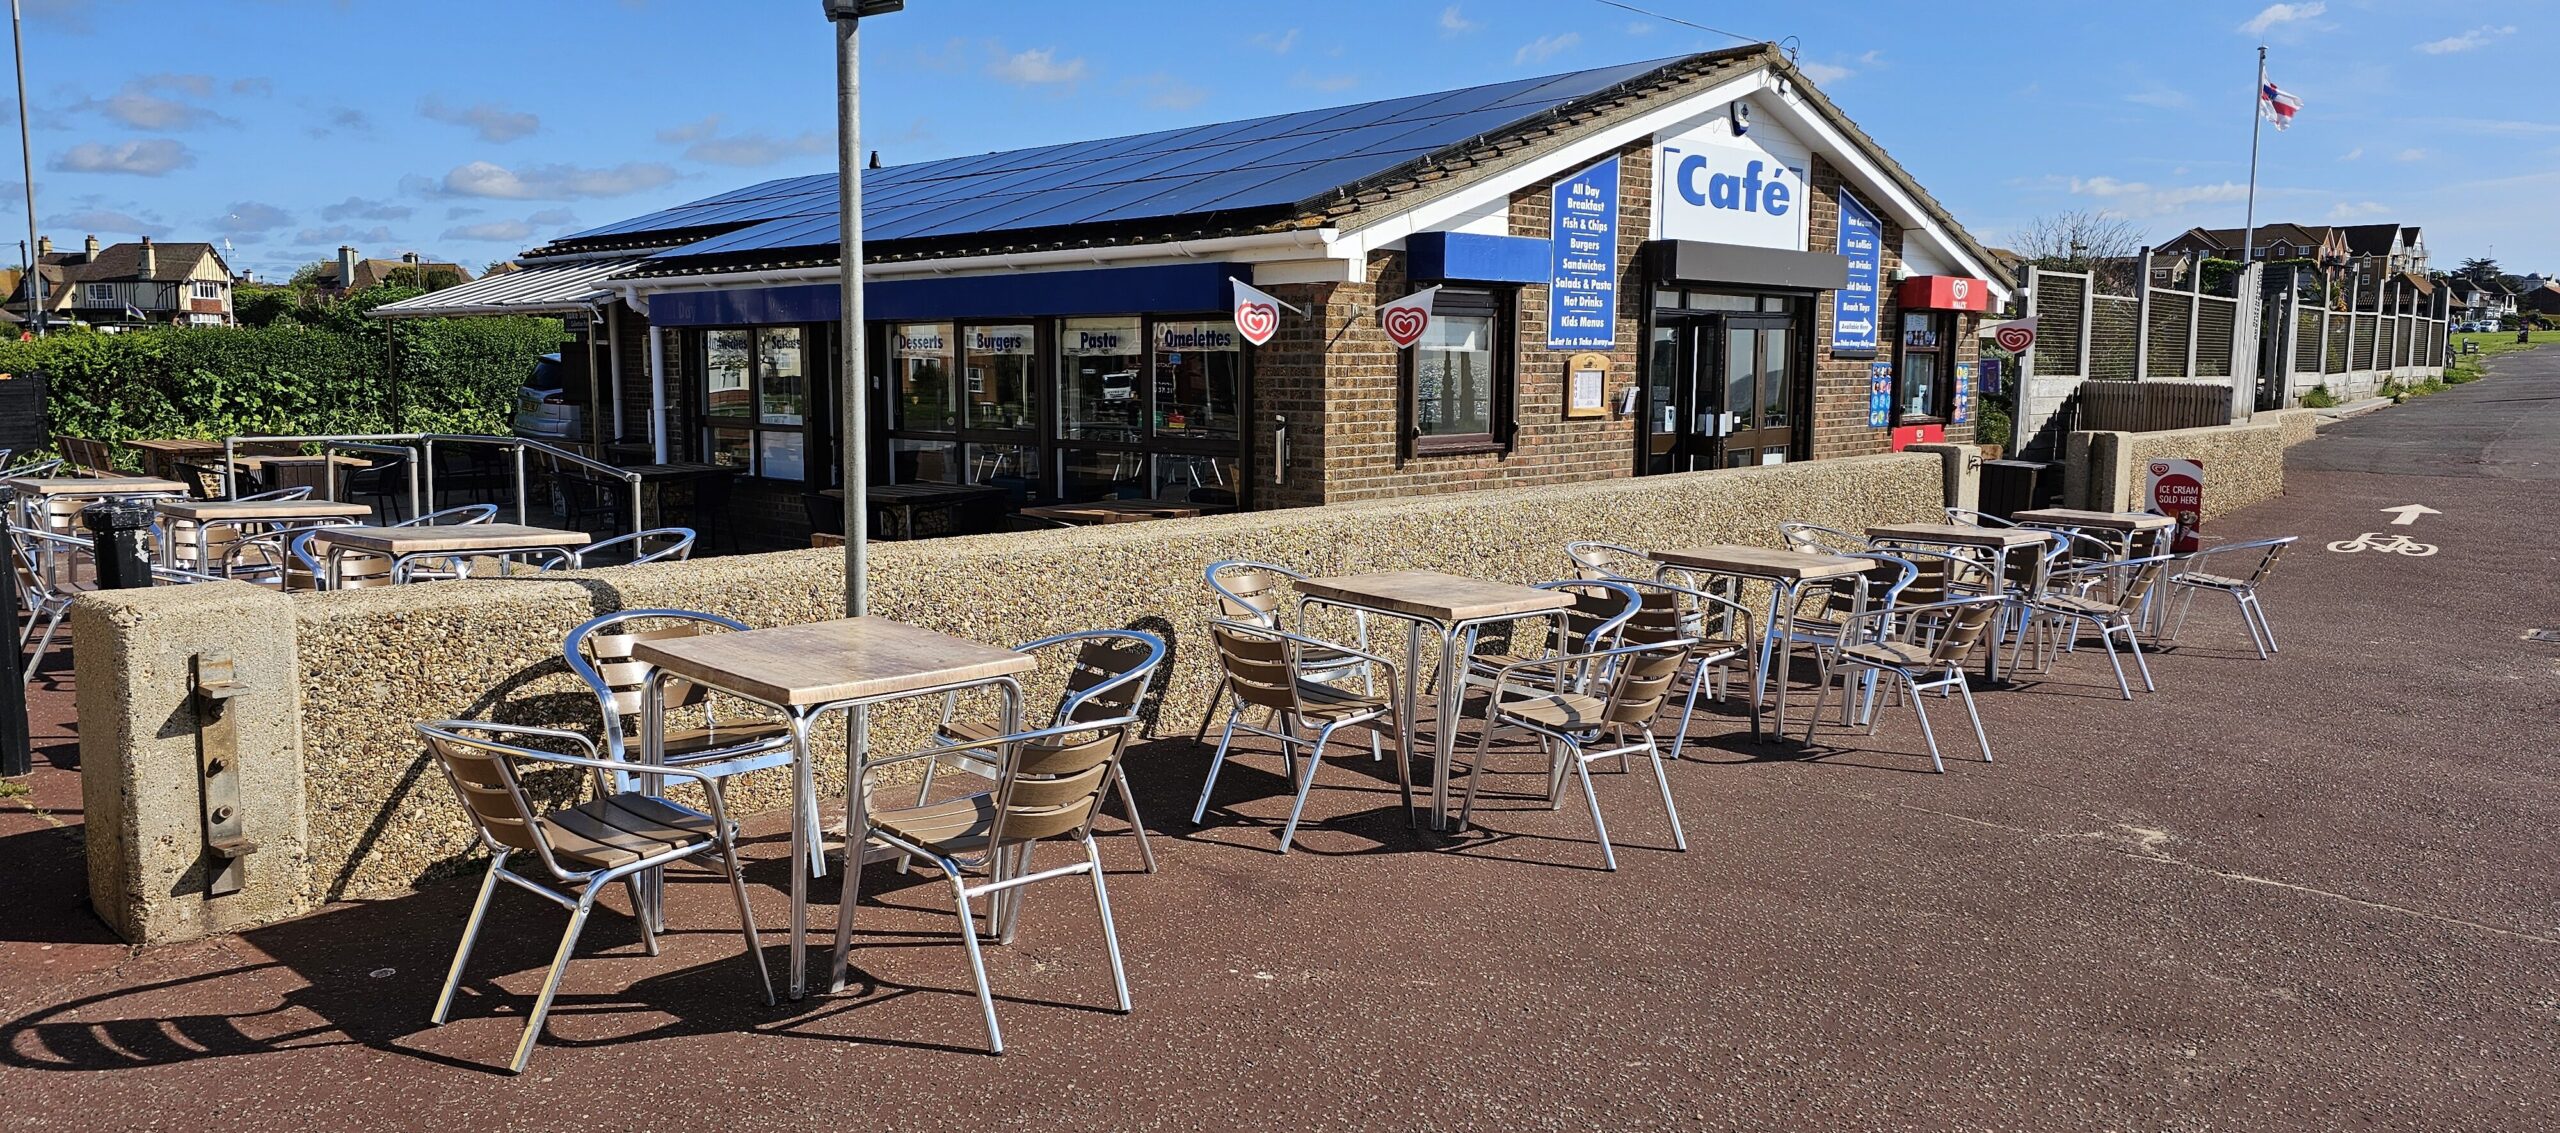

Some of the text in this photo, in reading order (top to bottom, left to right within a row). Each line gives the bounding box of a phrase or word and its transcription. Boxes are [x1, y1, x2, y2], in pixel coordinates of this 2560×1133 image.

[1572, 183, 1600, 198] All Day
[1677, 154, 1790, 216] Café
[1567, 197, 1605, 212] Breakfast
[1562, 217, 1608, 232] Fish & Chips
[1570, 238, 1600, 252] Burgers
[1562, 258, 1606, 271] Sandwiches
[1855, 260, 1872, 270] Drinks
[1555, 277, 1612, 291] Salads & Pasta
[1856, 282, 1872, 292] Drinks
[1563, 296, 1603, 308] Hot Drinks
[1561, 315, 1604, 328] Kids Menus
[900, 334, 944, 350] Desserts
[976, 332, 1022, 352] Burgers
[1080, 331, 1117, 349] Pasta
[1165, 327, 1232, 347] Omelettes
[1555, 337, 1565, 346] Eat
[1572, 337, 1578, 346] &
[1579, 337, 1592, 346] Take
[1593, 337, 1608, 347] Away
[2159, 485, 2199, 495] ICE CREAM
[2159, 495, 2198, 505] SOLD HERE
